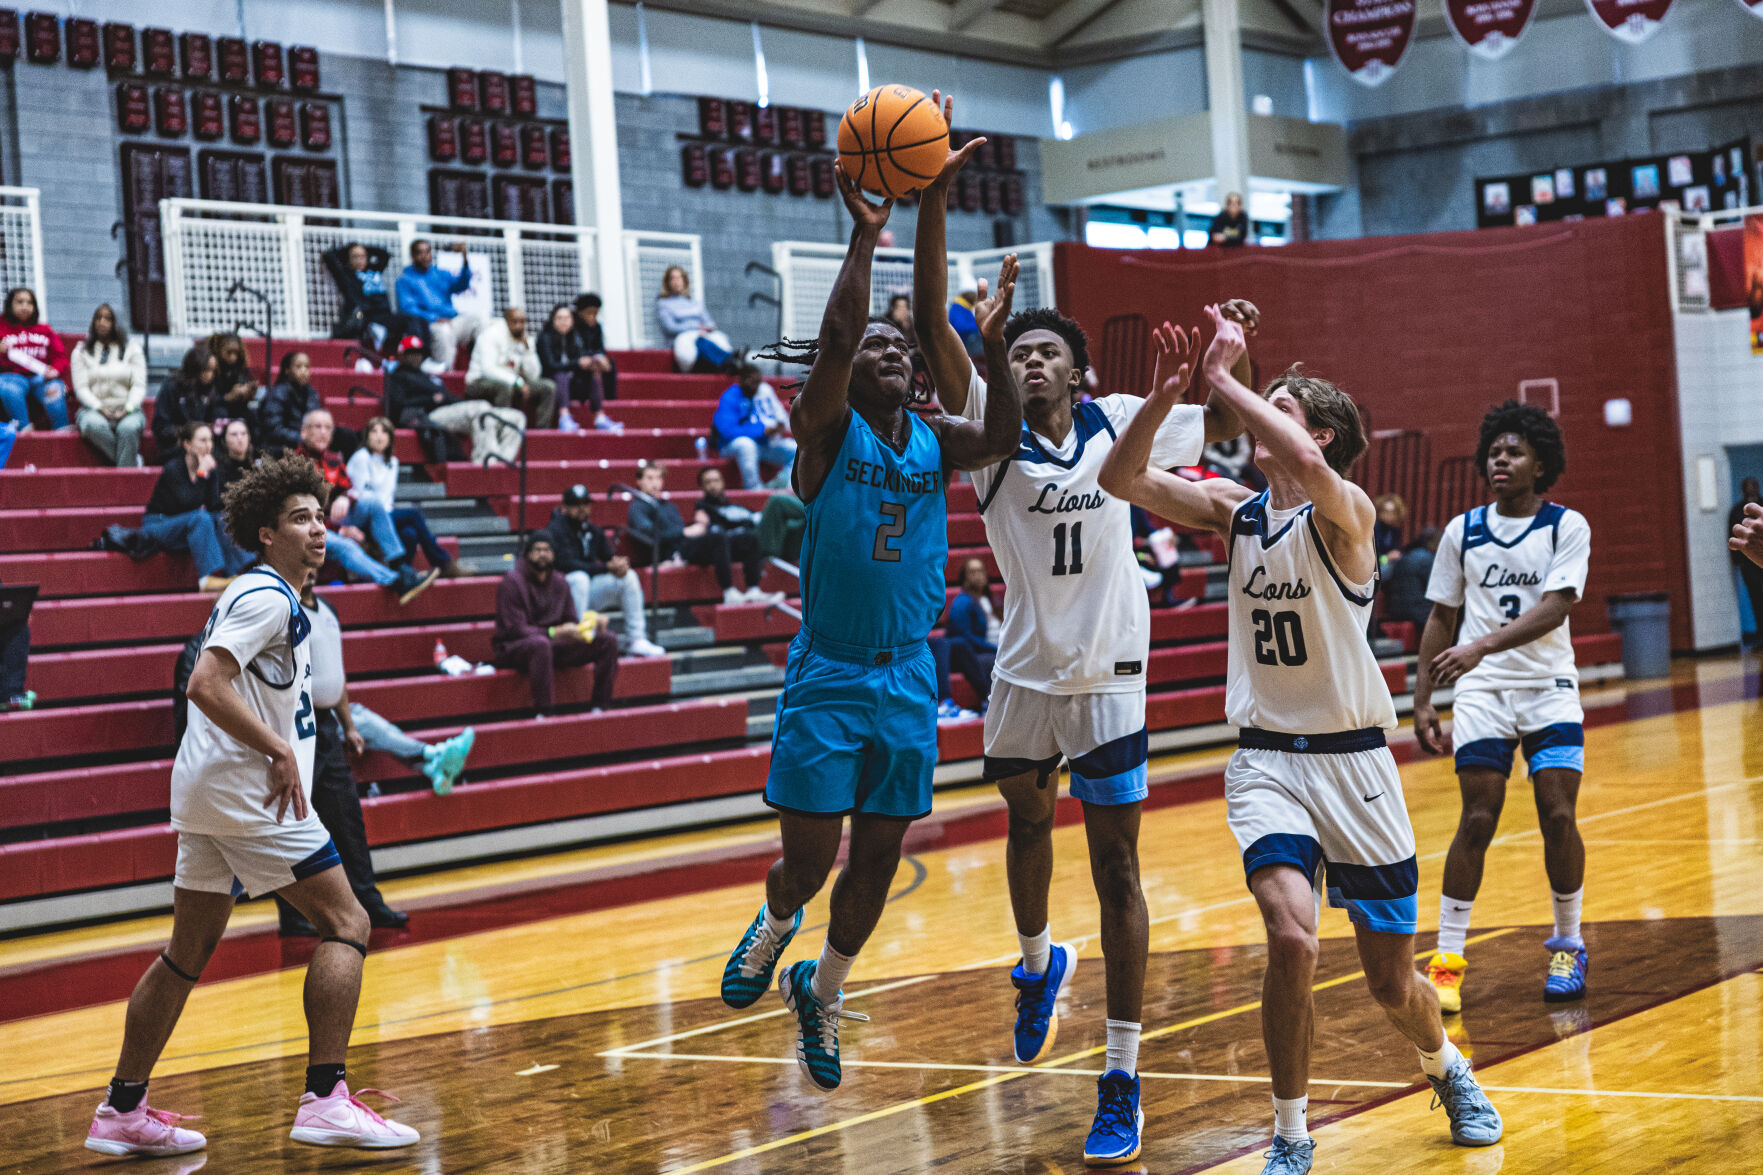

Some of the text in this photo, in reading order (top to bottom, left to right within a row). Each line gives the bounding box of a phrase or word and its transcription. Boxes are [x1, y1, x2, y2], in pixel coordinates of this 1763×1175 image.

[845, 457, 939, 495] SECKINGER
[1028, 482, 1105, 515] Lions
[872, 500, 906, 562] 2
[1052, 521, 1083, 576] 11
[1480, 563, 1542, 589] Lions
[1251, 608, 1308, 666] 20
